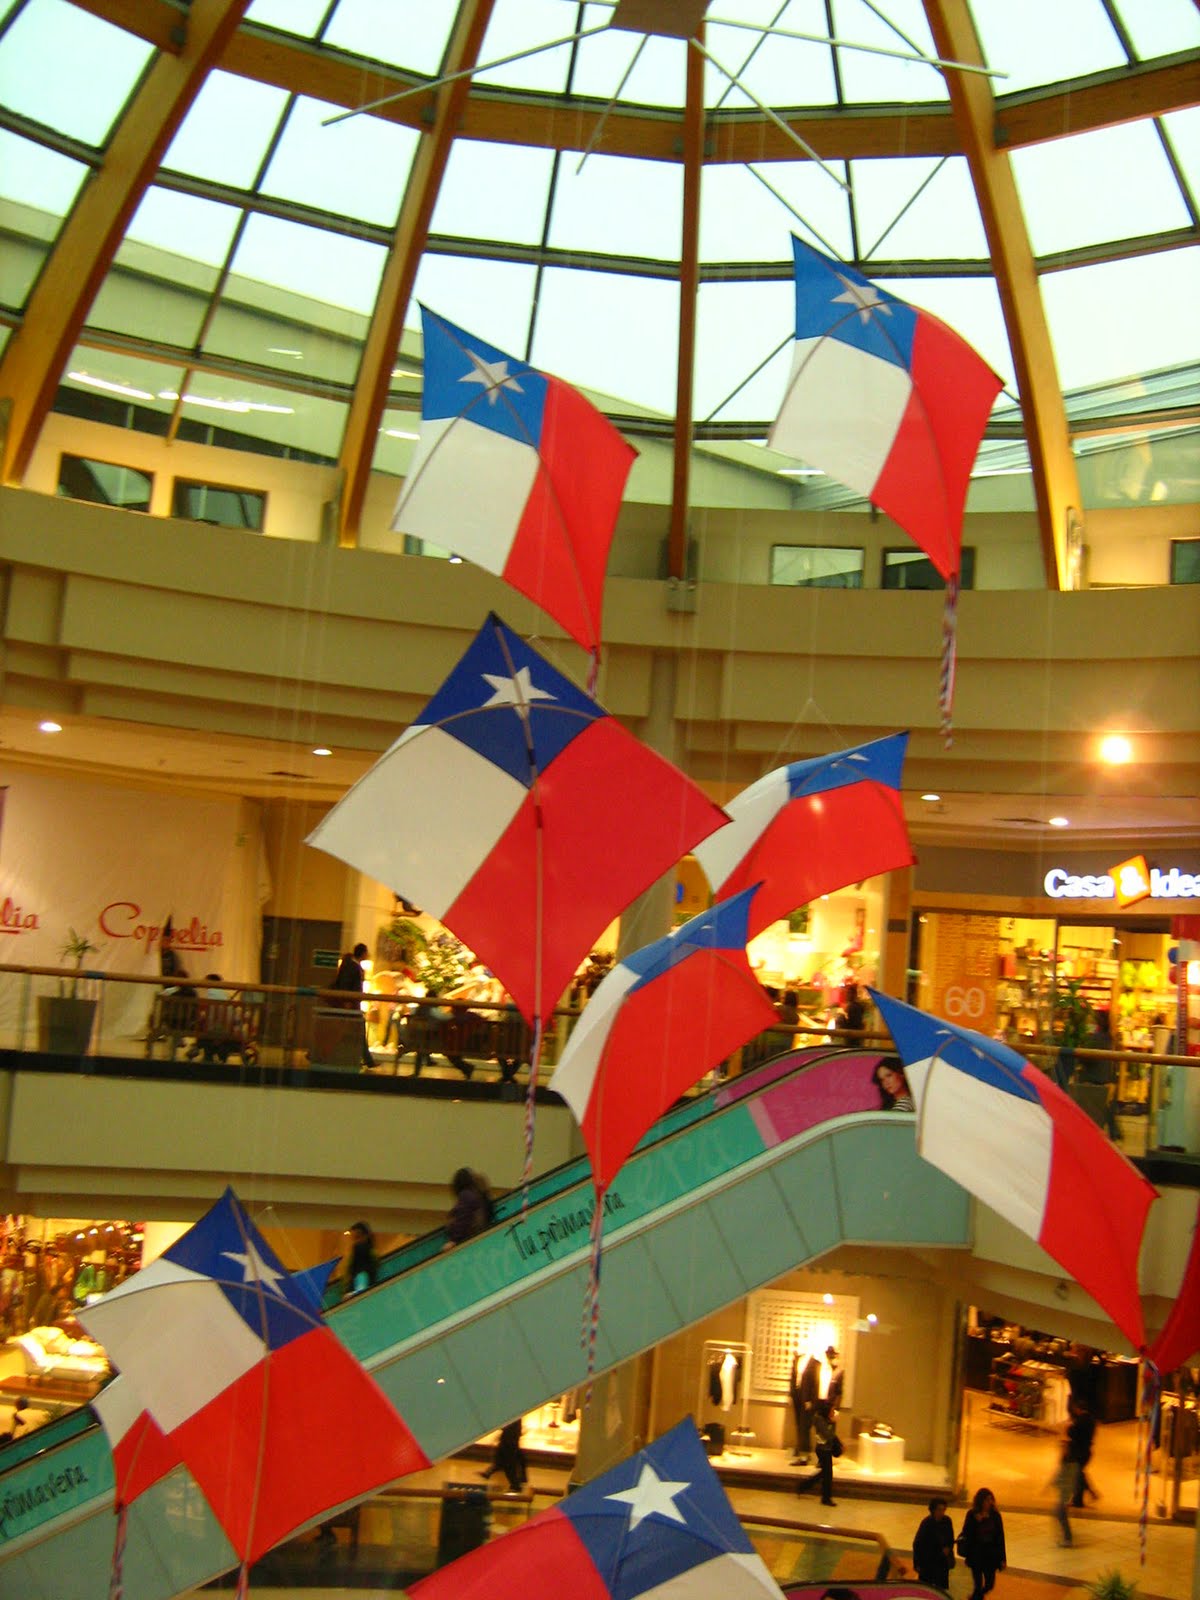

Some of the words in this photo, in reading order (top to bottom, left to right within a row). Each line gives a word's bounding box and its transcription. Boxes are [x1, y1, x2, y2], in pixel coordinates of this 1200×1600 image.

[1044, 868, 1115, 898] Casa
[944, 986, 985, 1018] 60
[504, 1219, 538, 1260] Tu
[537, 1192, 624, 1261] primavra
